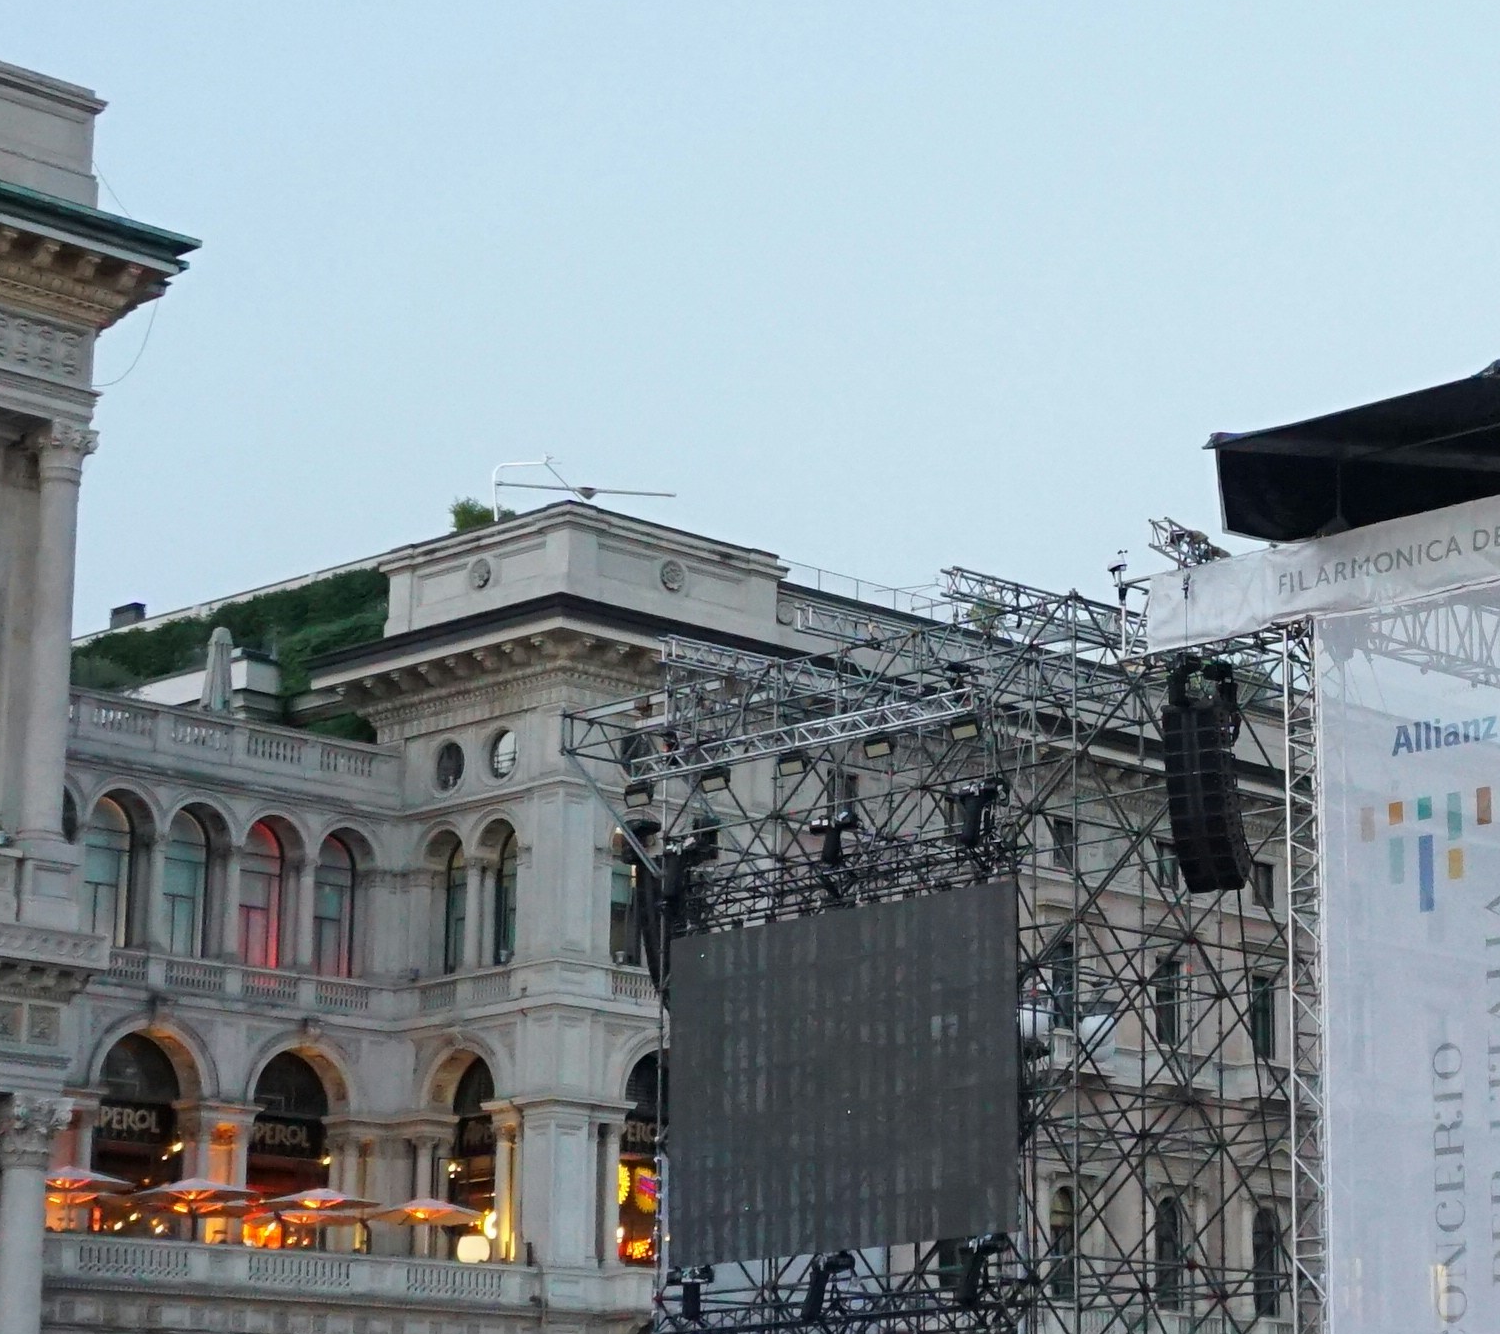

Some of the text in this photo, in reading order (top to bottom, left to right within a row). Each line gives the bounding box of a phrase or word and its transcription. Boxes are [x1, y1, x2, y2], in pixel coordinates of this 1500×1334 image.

[1277, 535, 1462, 596] FILARMONICA
[1392, 715, 1498, 757] Allianz
[253, 1121, 310, 1147] PEROL
